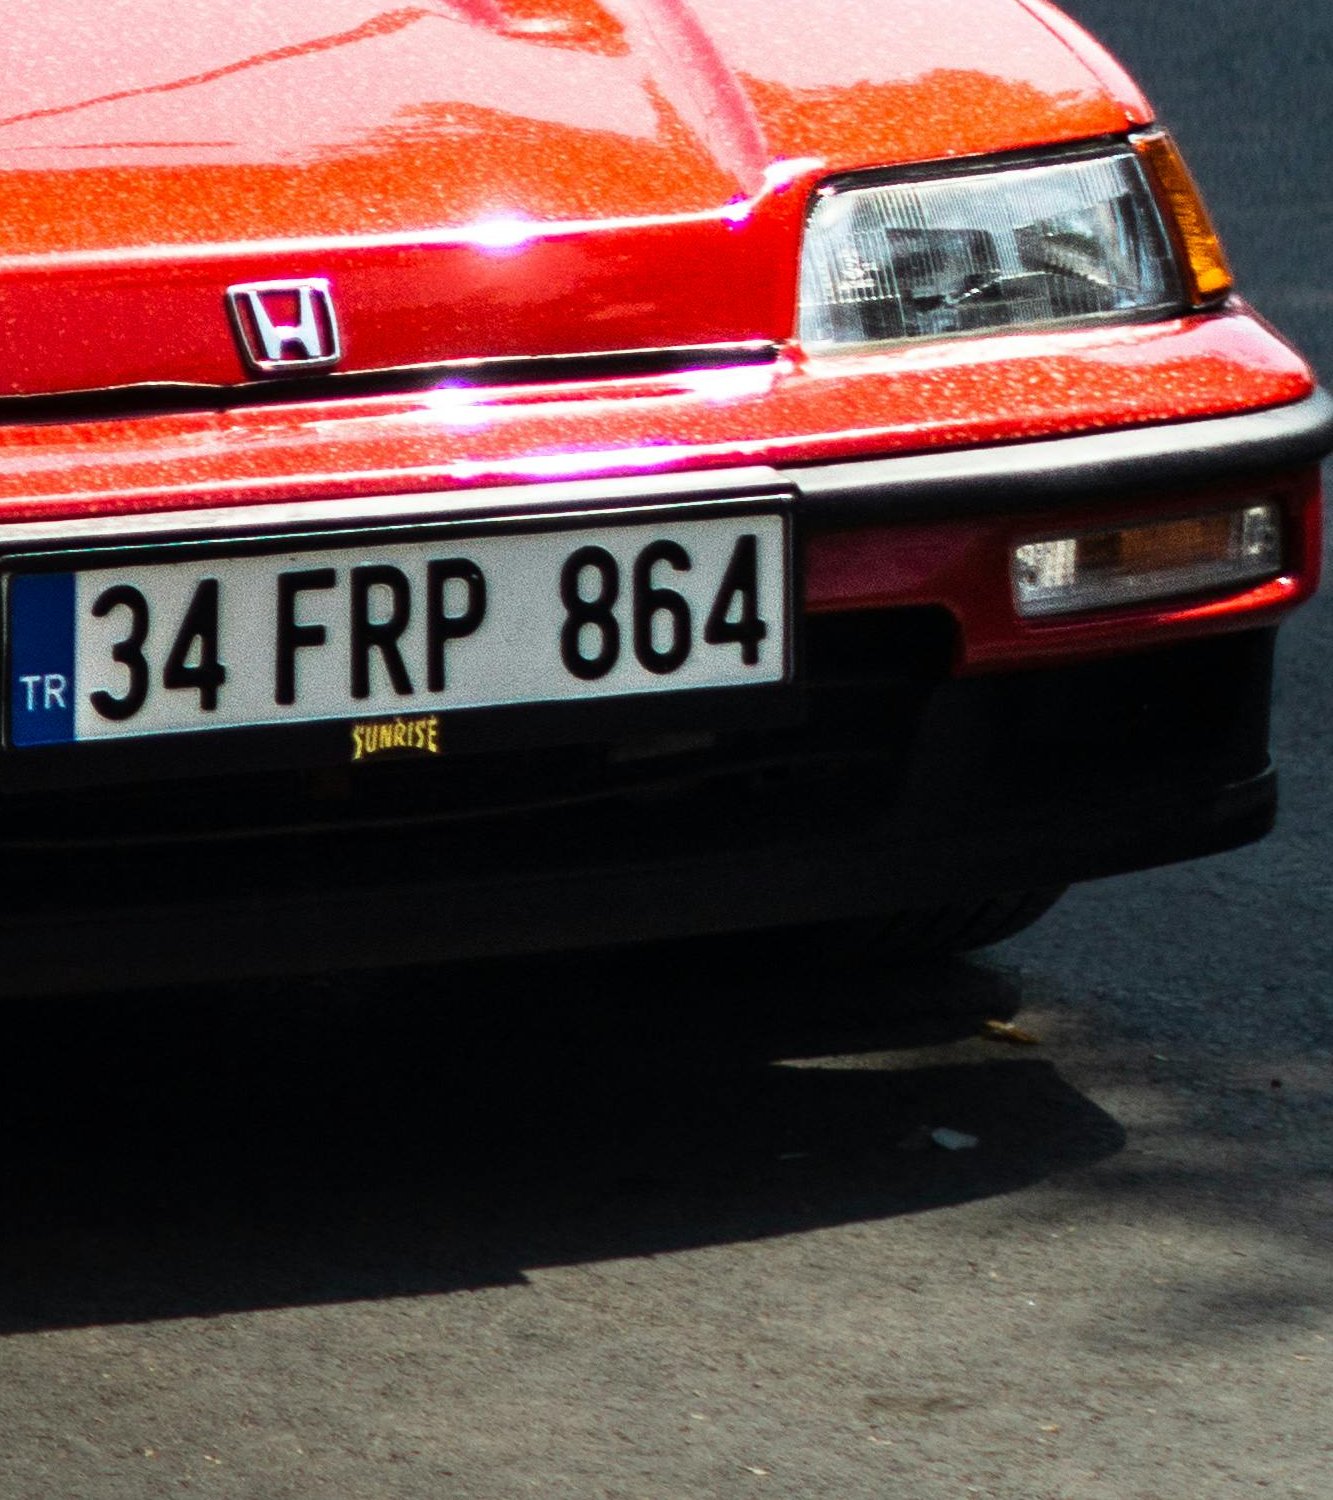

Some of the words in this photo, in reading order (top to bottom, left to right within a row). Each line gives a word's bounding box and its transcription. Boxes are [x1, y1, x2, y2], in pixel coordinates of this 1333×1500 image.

[89, 577, 227, 721] 34
[274, 556, 487, 706] FRP
[558, 533, 768, 682] 864
[19, 674, 67, 711] TR
[351, 714, 439, 760] SUNRISE
